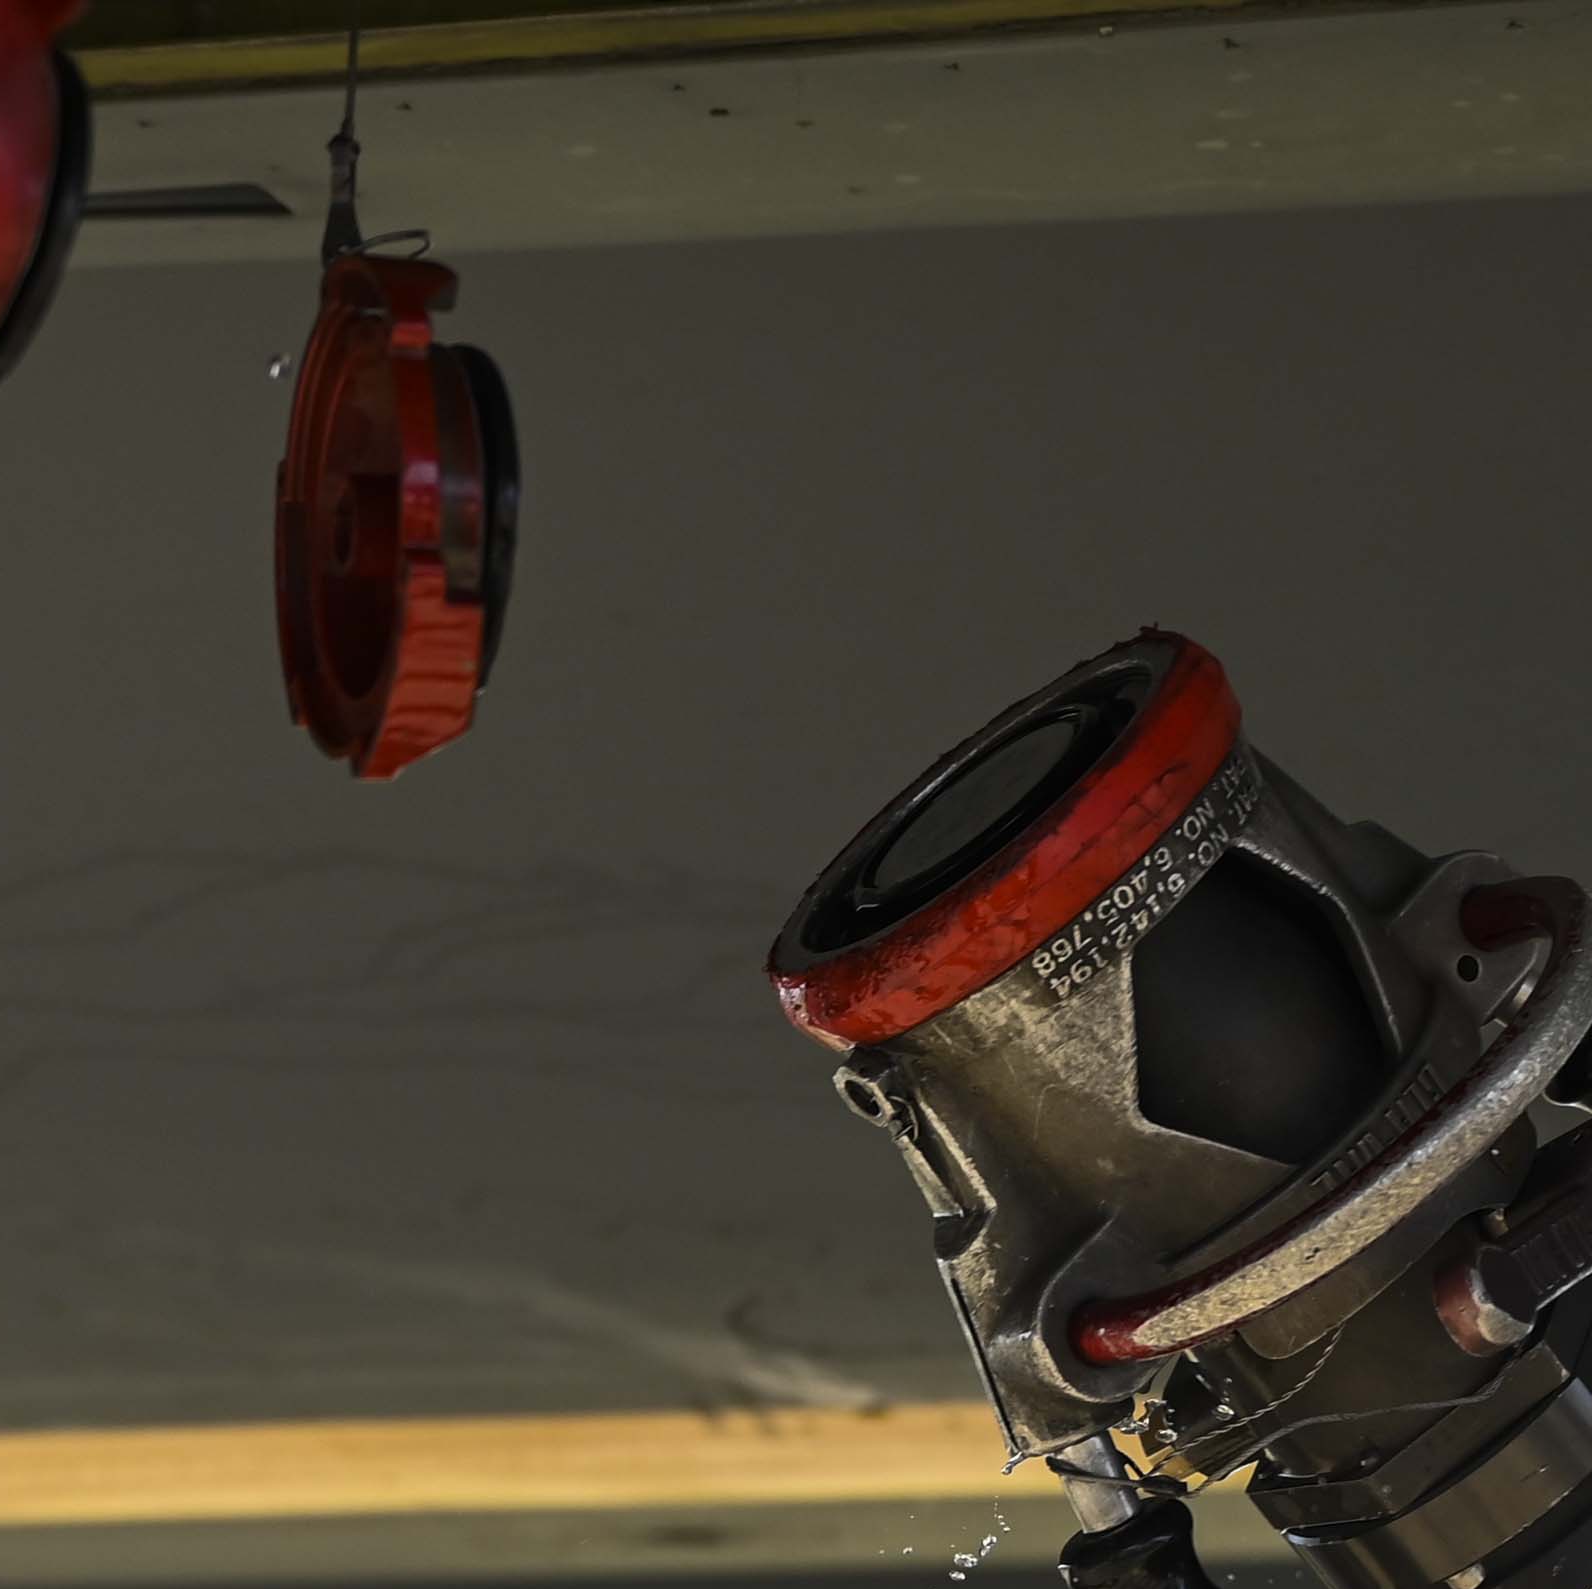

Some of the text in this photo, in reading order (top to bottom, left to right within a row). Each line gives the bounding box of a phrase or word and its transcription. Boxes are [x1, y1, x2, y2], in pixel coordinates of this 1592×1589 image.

[1175, 799, 1216, 841] NO.
[1188, 823, 1229, 867] NO.
[1031, 846, 1174, 979] 6,405,768
